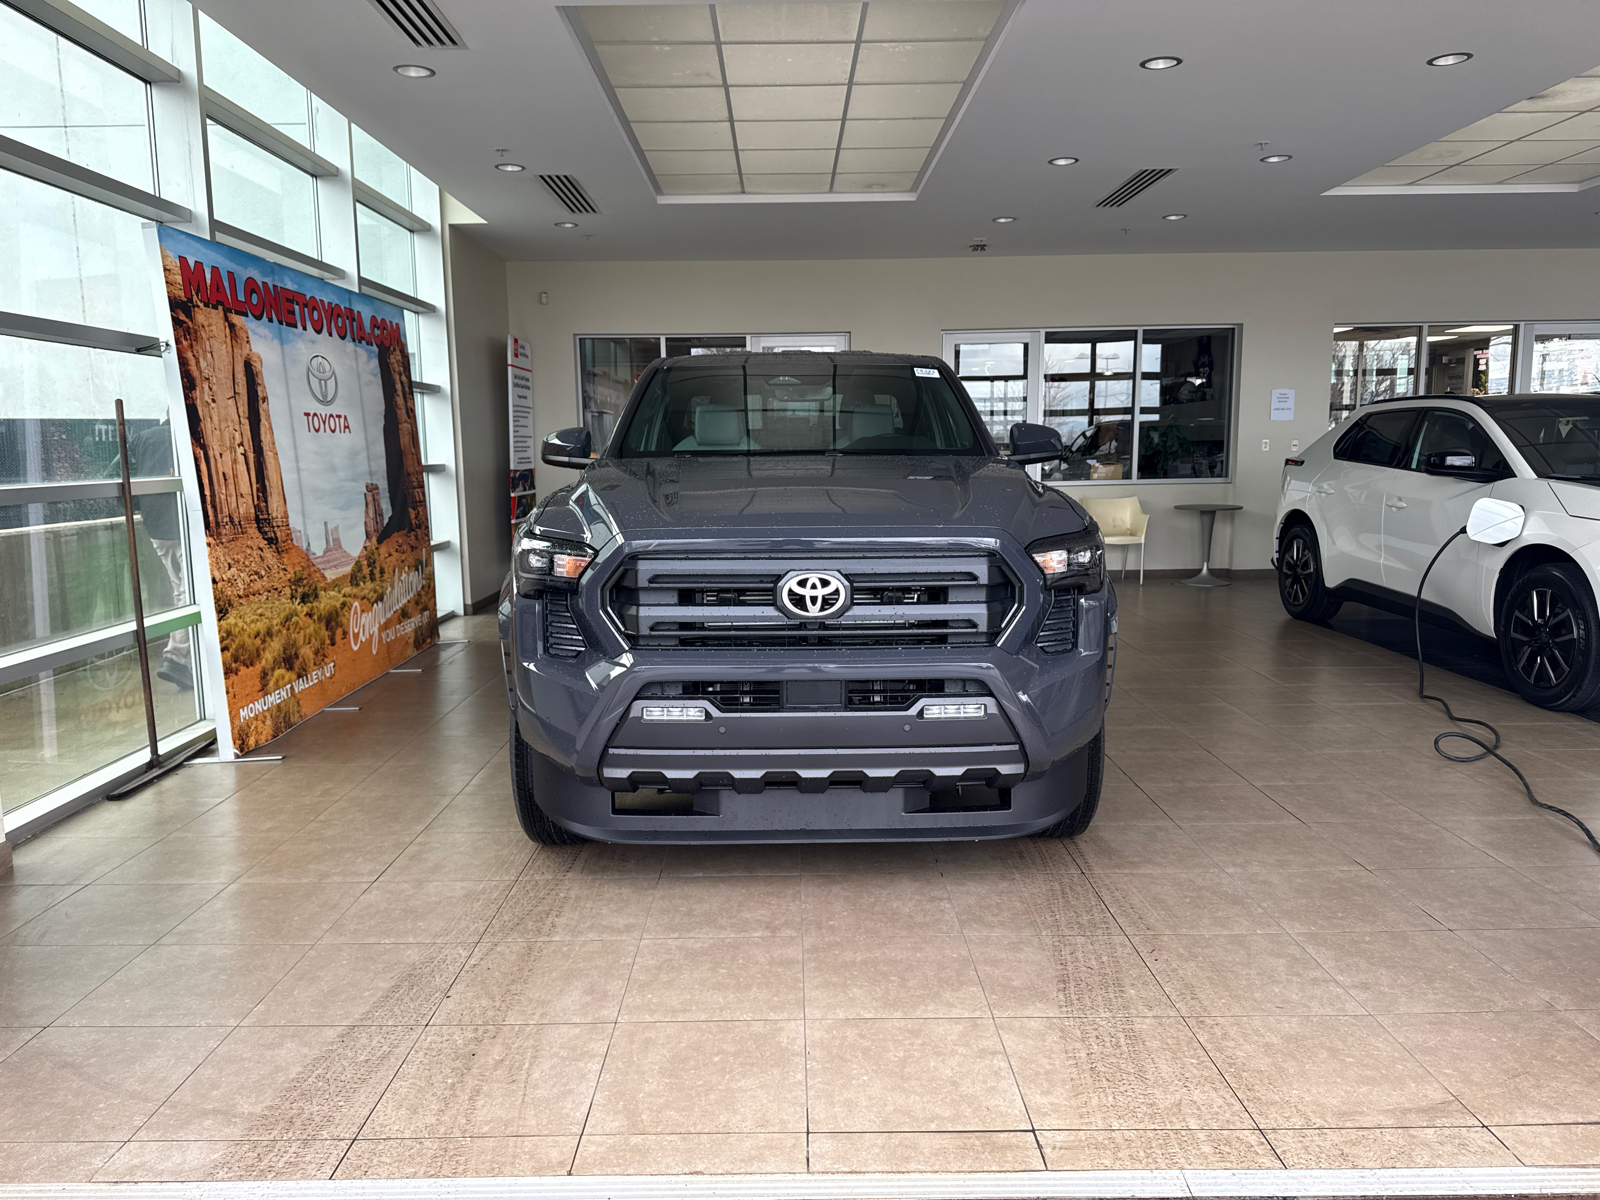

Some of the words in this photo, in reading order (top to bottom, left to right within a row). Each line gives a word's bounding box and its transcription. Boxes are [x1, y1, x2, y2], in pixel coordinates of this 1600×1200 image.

[178, 255, 401, 349] MALONETOYOTA.COM
[303, 411, 351, 435] TOYOTA
[350, 547, 426, 655] Congratulations!
[381, 626, 396, 644] YOU
[396, 613, 422, 637] DESERVE
[238, 683, 291, 723] MONUMENT
[292, 668, 325, 694] VALLEY,
[324, 661, 335, 677] UT
